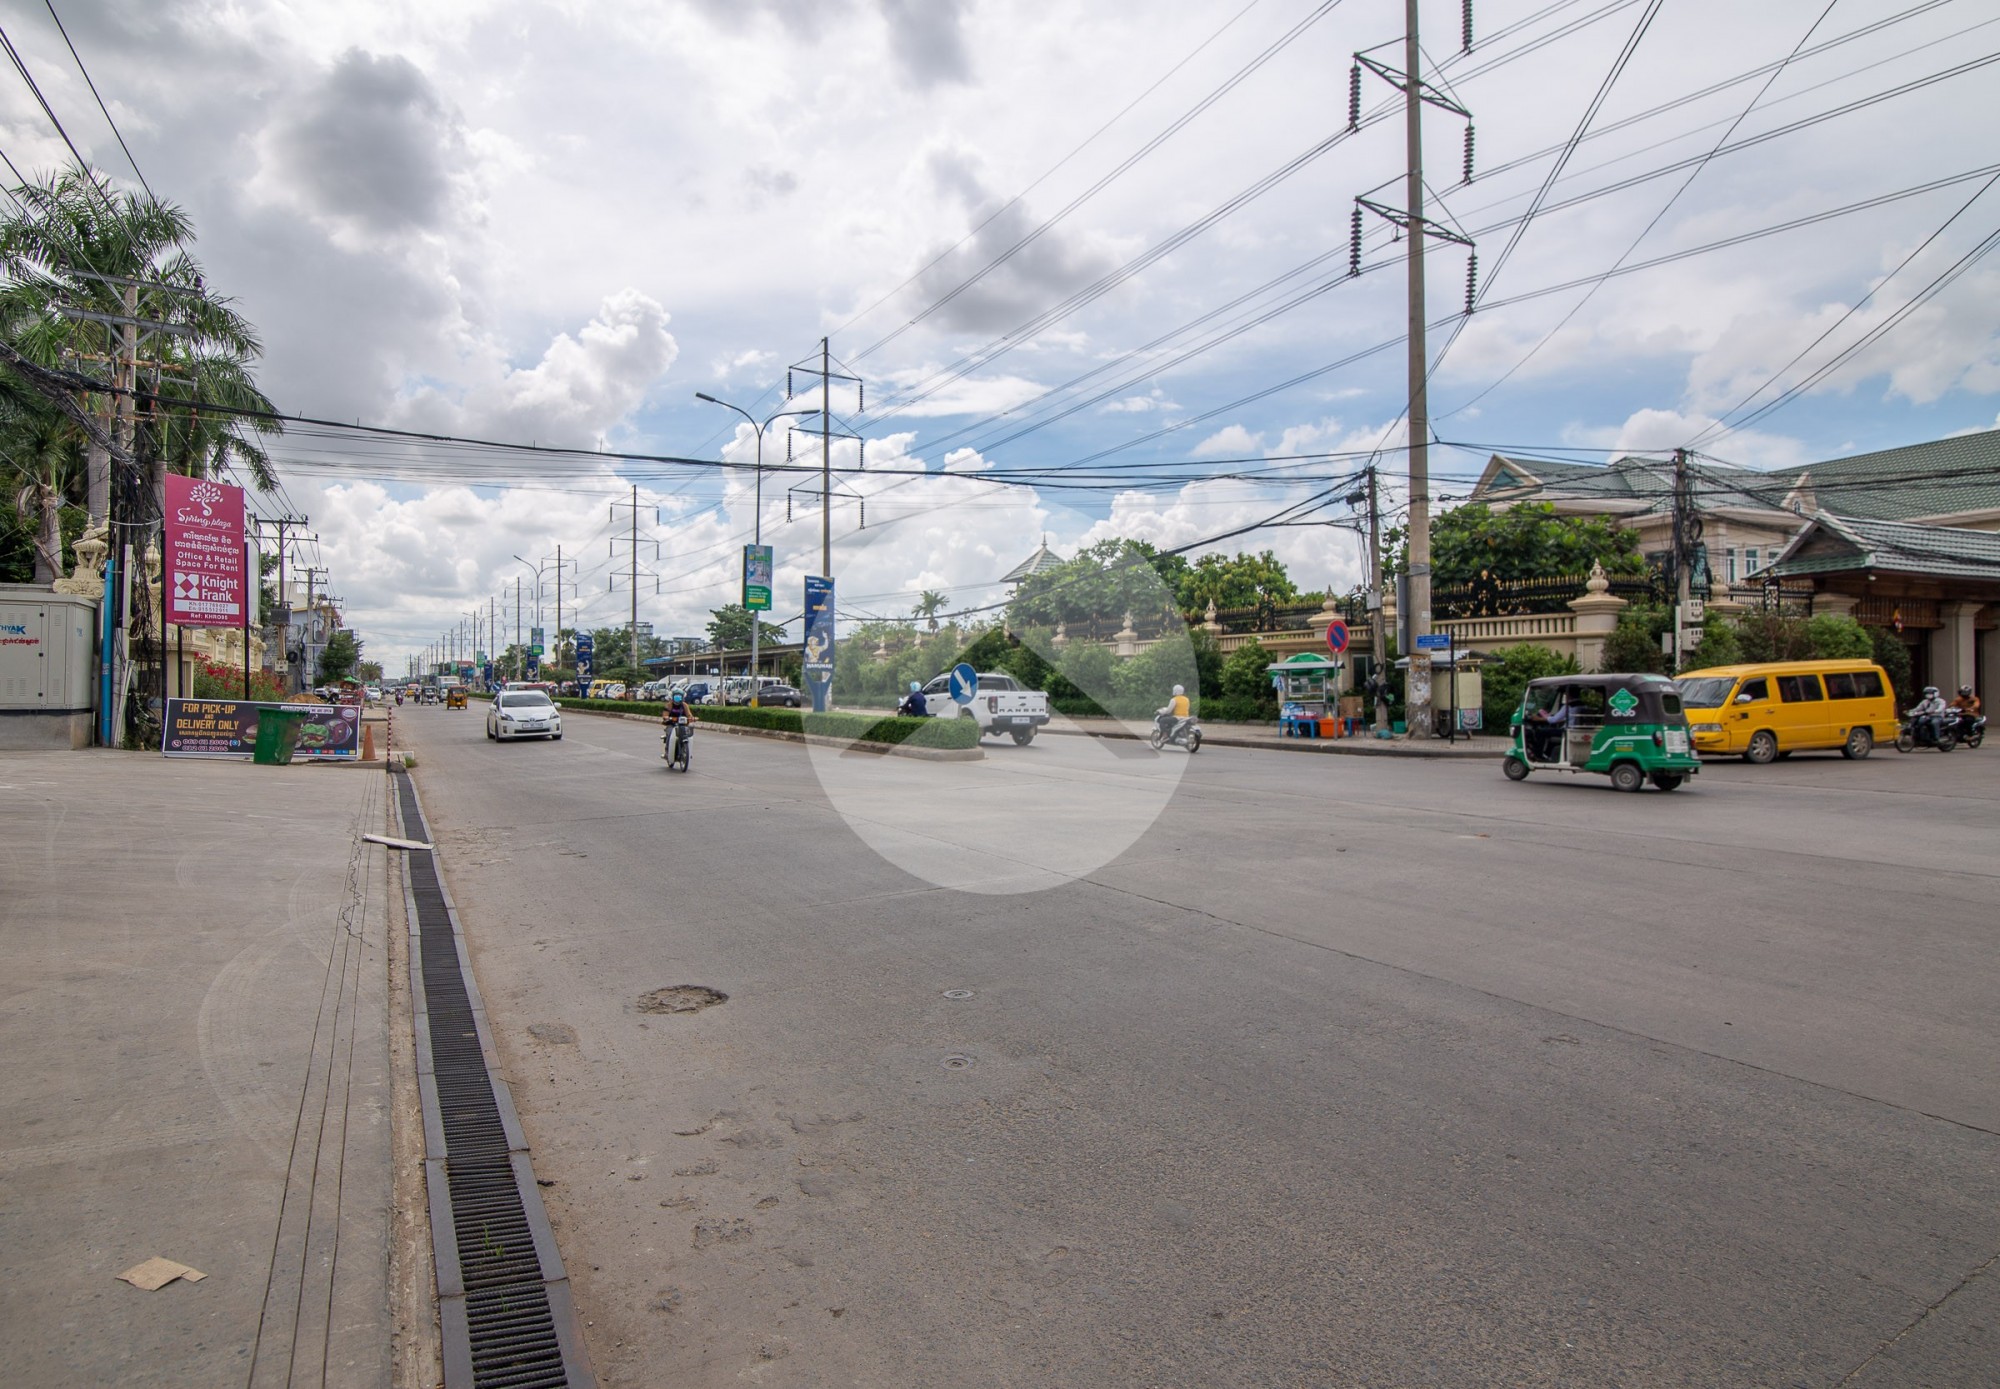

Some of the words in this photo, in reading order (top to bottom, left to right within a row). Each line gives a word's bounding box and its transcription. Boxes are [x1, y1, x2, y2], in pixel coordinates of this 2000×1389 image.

[177, 507, 211, 527] Spring
[175, 558, 201, 567] Space
[204, 562, 217, 570] For
[177, 551, 203, 561] Office
[205, 554, 212, 562] &
[214, 555, 237, 564] Retail
[201, 575, 238, 591] Knight
[201, 588, 233, 602] Frank
[182, 703, 199, 713] FOR
[202, 703, 236, 714] PICK-UP
[176, 718, 216, 730] DELIVERY
[217, 720, 240, 730] ONLY
